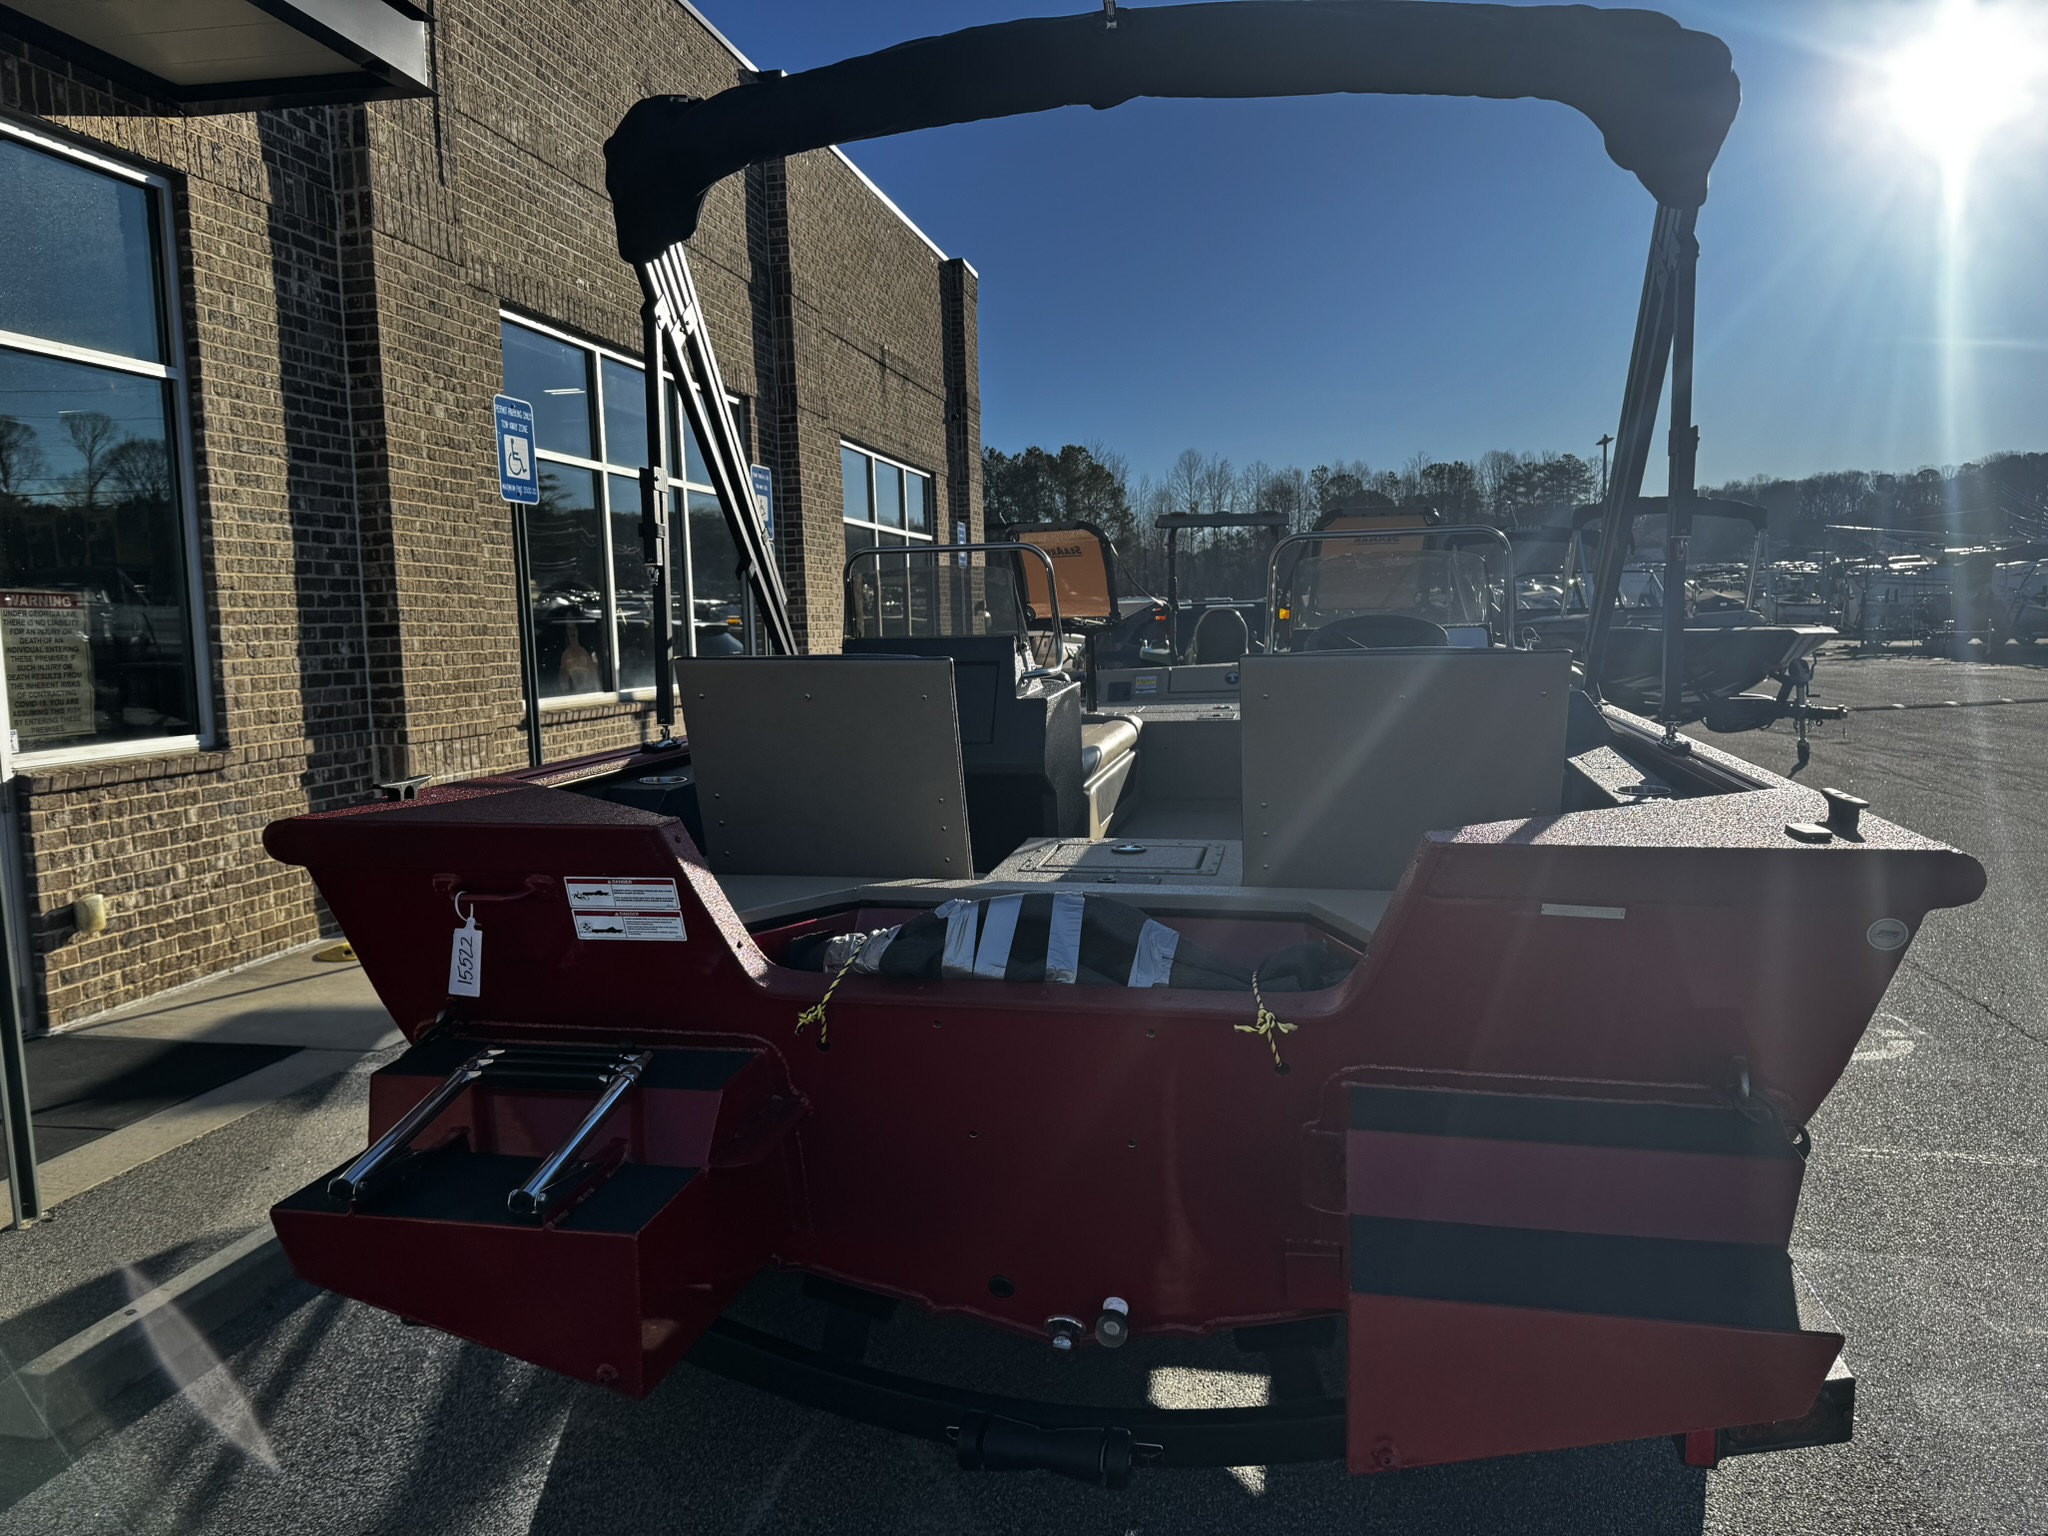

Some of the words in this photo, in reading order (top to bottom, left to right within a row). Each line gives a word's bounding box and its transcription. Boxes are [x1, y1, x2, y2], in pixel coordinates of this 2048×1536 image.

[5, 594, 72, 607] WARNING
[3, 609, 27, 617] UNDER
[29, 610, 61, 618] GEORGIA
[36, 619, 46, 627] NO
[47, 619, 80, 627] LIABILITY
[37, 628, 61, 636] INJURY
[19, 637, 42, 645] DEATH
[6, 646, 44, 654] INDIVIDUAL
[45, 645, 80, 653] ENTERING
[16, 664, 36, 672] SUCH
[37, 663, 61, 671] INJURY
[7, 673, 31, 681] DEATH
[28, 690, 77, 698] CONTRACTING
[12, 709, 49, 717] ASSUMING
[24, 717, 59, 726] ENTERING
[60, 715, 82, 723] THESE
[457, 935, 474, 985] 15522
